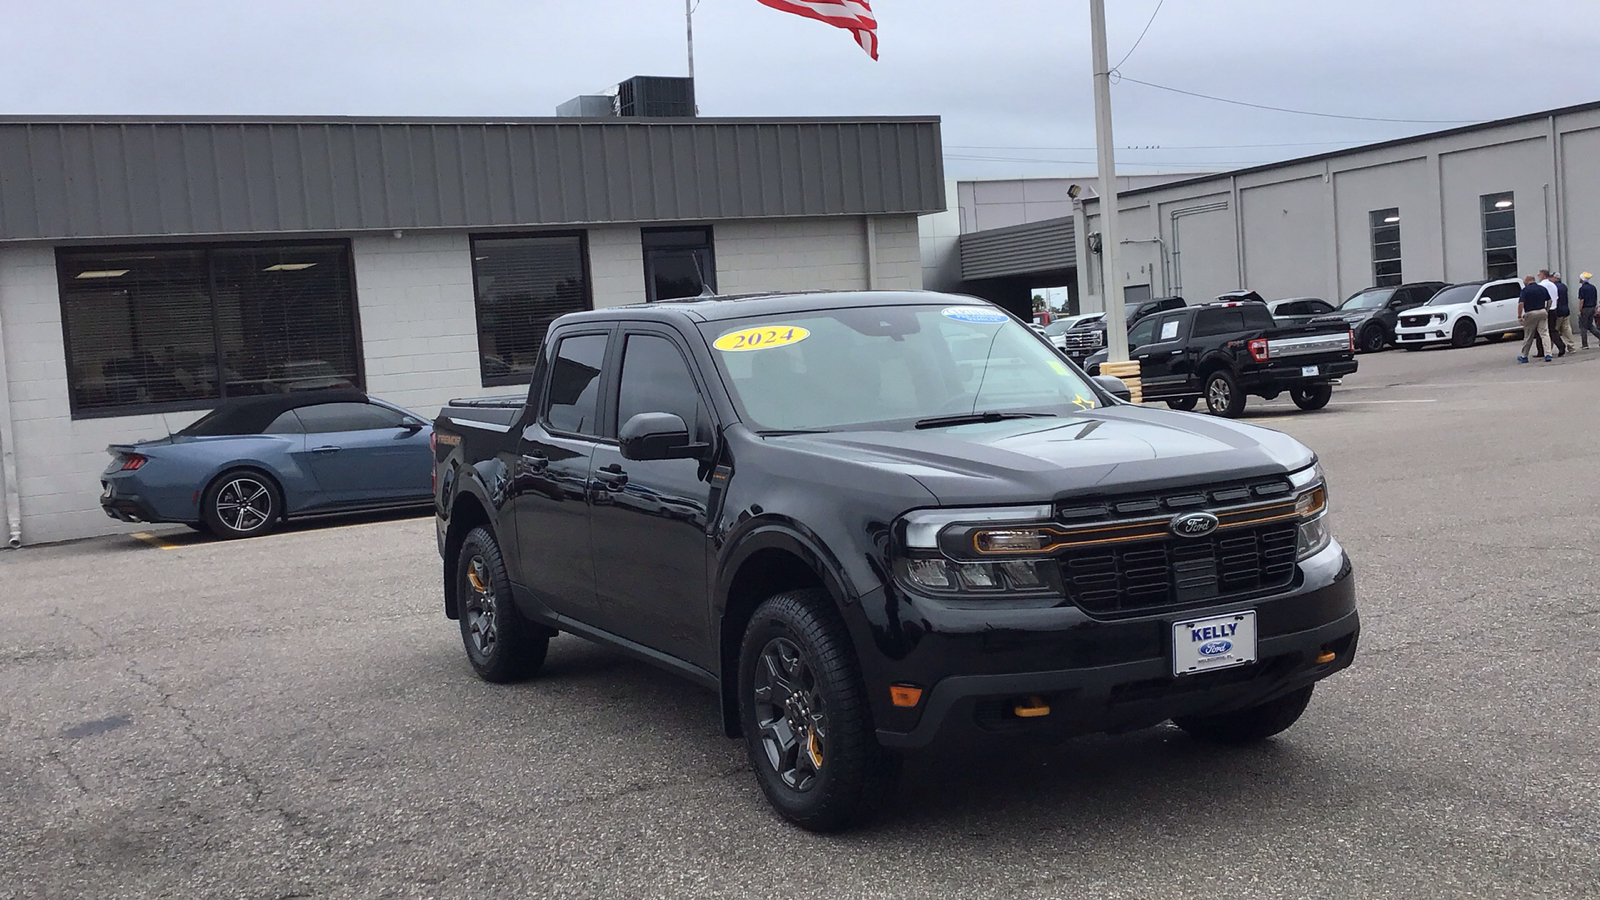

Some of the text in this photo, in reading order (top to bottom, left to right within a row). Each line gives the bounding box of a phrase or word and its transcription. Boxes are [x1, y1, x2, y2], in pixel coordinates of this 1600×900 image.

[733, 328, 794, 349] 2024
[1185, 517, 1210, 533] Ford
[1191, 622, 1238, 642] KELLY
[1205, 641, 1227, 654] Ford
